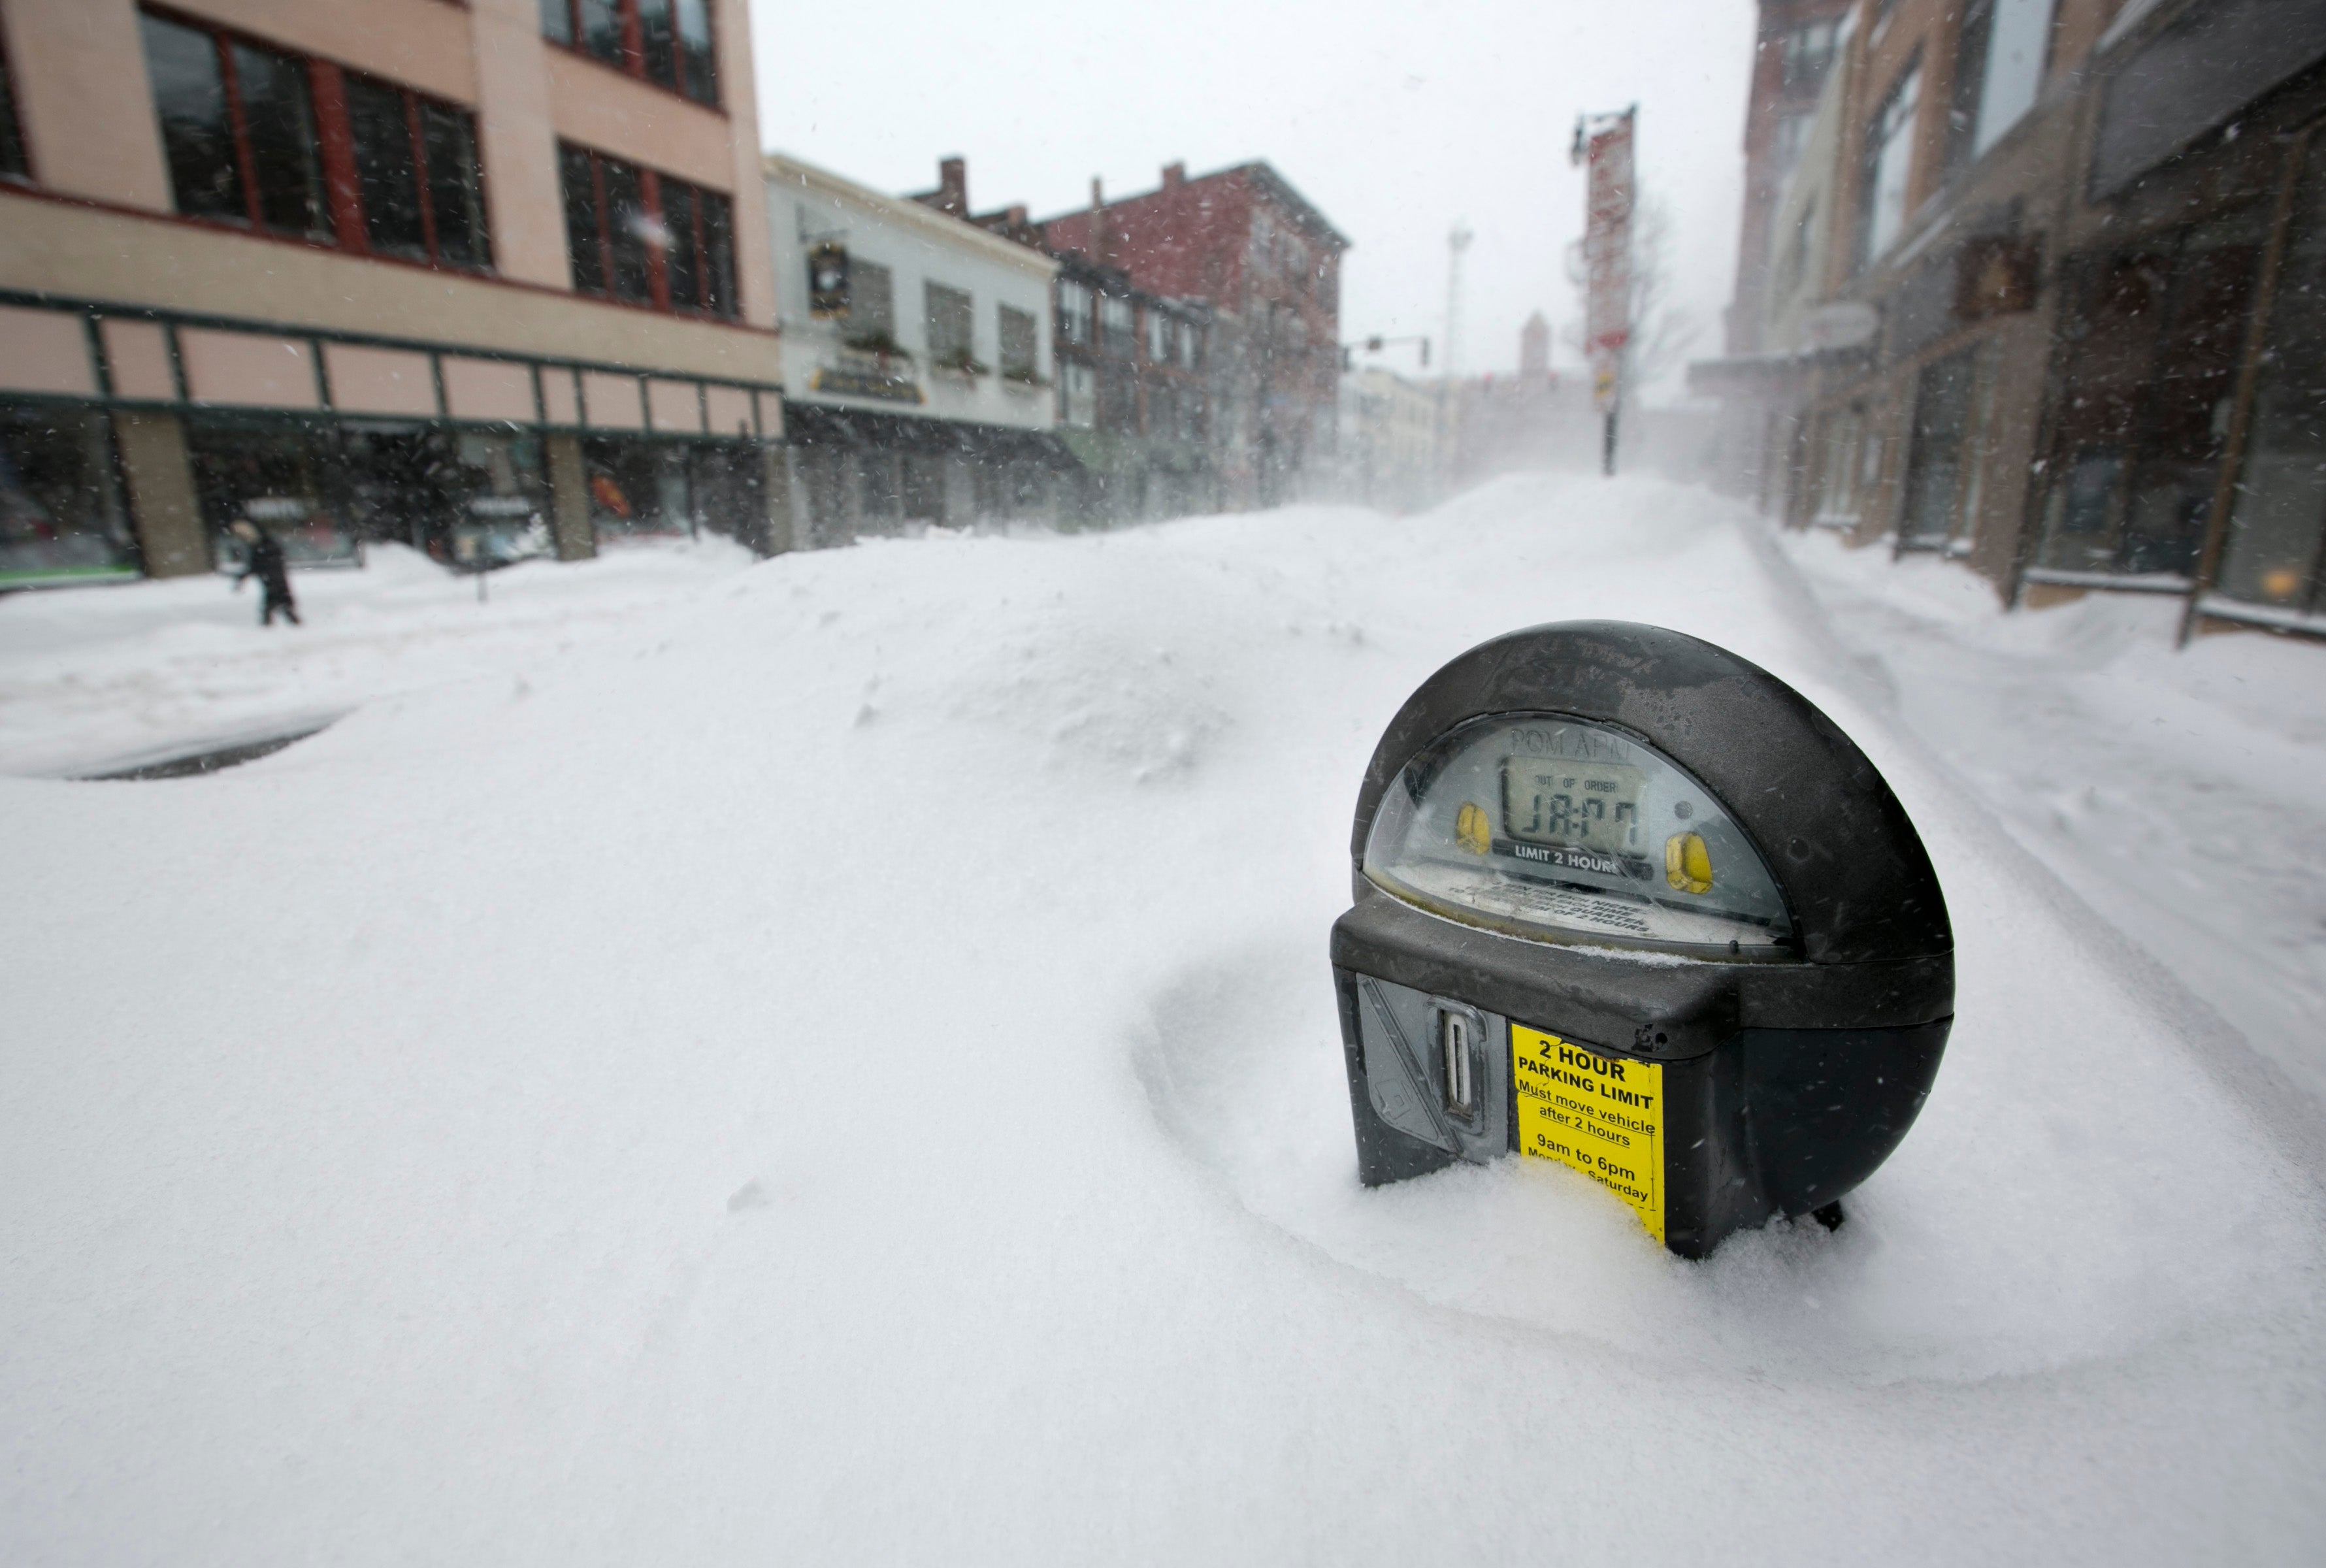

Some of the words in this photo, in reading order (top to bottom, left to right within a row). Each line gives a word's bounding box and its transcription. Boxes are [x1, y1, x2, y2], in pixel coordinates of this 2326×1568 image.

[1511, 728, 1564, 755] POM
[1563, 777, 1575, 789] OF
[1584, 779, 1616, 793] ORDER
[1515, 845, 1550, 861] LIMIT
[1554, 853, 1563, 864] 2
[1568, 854, 1619, 874] HOUR
[1570, 907, 1645, 925] QUARTER
[1589, 917, 1650, 932] HOURS
[1592, 906, 1634, 916] DIME
[1539, 1039, 1551, 1058] 2
[1559, 1047, 1626, 1082] HOUR
[1518, 1056, 1595, 1092] PARKING
[1601, 1083, 1654, 1109] LIMIT
[1519, 1079, 1552, 1101] Must
[1556, 1094, 1594, 1115] move
[1599, 1109, 1656, 1134] vehicle
[1539, 1107, 1571, 1124] after
[1575, 1117, 1583, 1129] 2
[1588, 1121, 1631, 1146] hours
[1537, 1134, 1571, 1156] 9am
[1576, 1148, 1592, 1164] to
[1597, 1156, 1635, 1181] 6pm
[1588, 1170, 1648, 1201] Saturday
